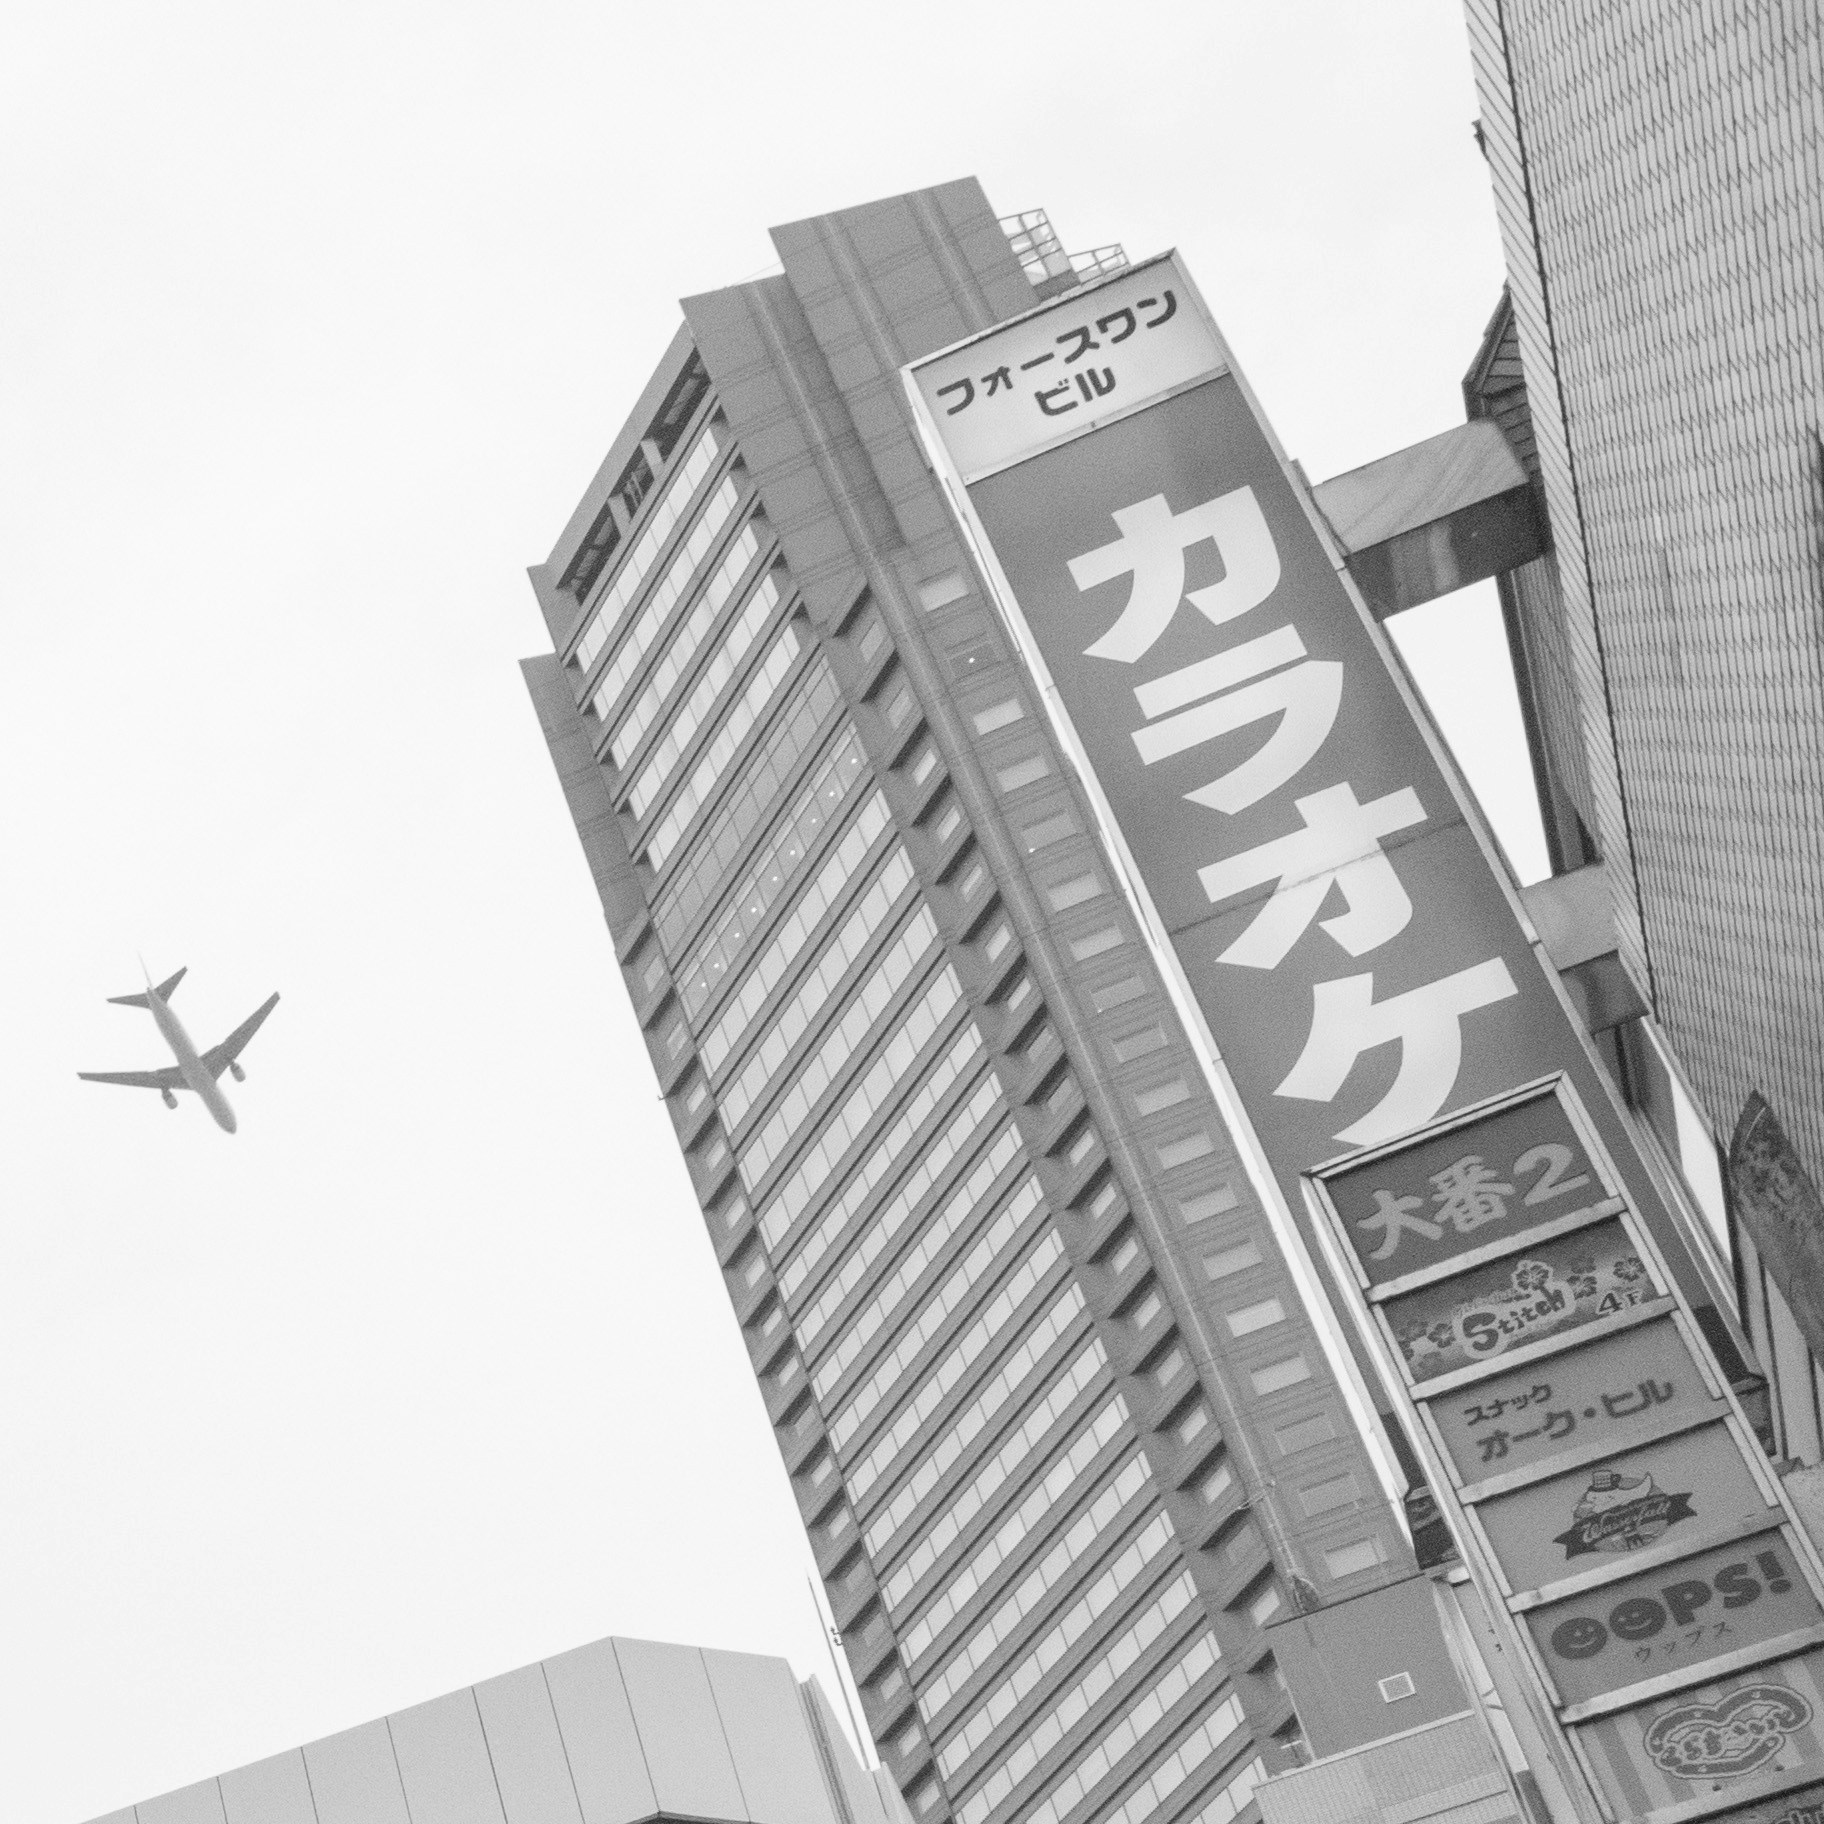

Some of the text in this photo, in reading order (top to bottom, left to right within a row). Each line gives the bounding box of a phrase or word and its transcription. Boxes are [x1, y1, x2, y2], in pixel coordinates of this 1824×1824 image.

[937, 287, 1179, 417] フォースワン
[1034, 365, 1118, 418] ビル
[1065, 484, 1521, 1147] カラオケ
[1357, 1142, 1590, 1260] 大番2
[1462, 1280, 1567, 1354] Stitch
[1463, 1383, 1553, 1428] スナック
[1550, 1550, 1793, 1661] OOPS!
[1633, 1620, 1733, 1665] ウップス
